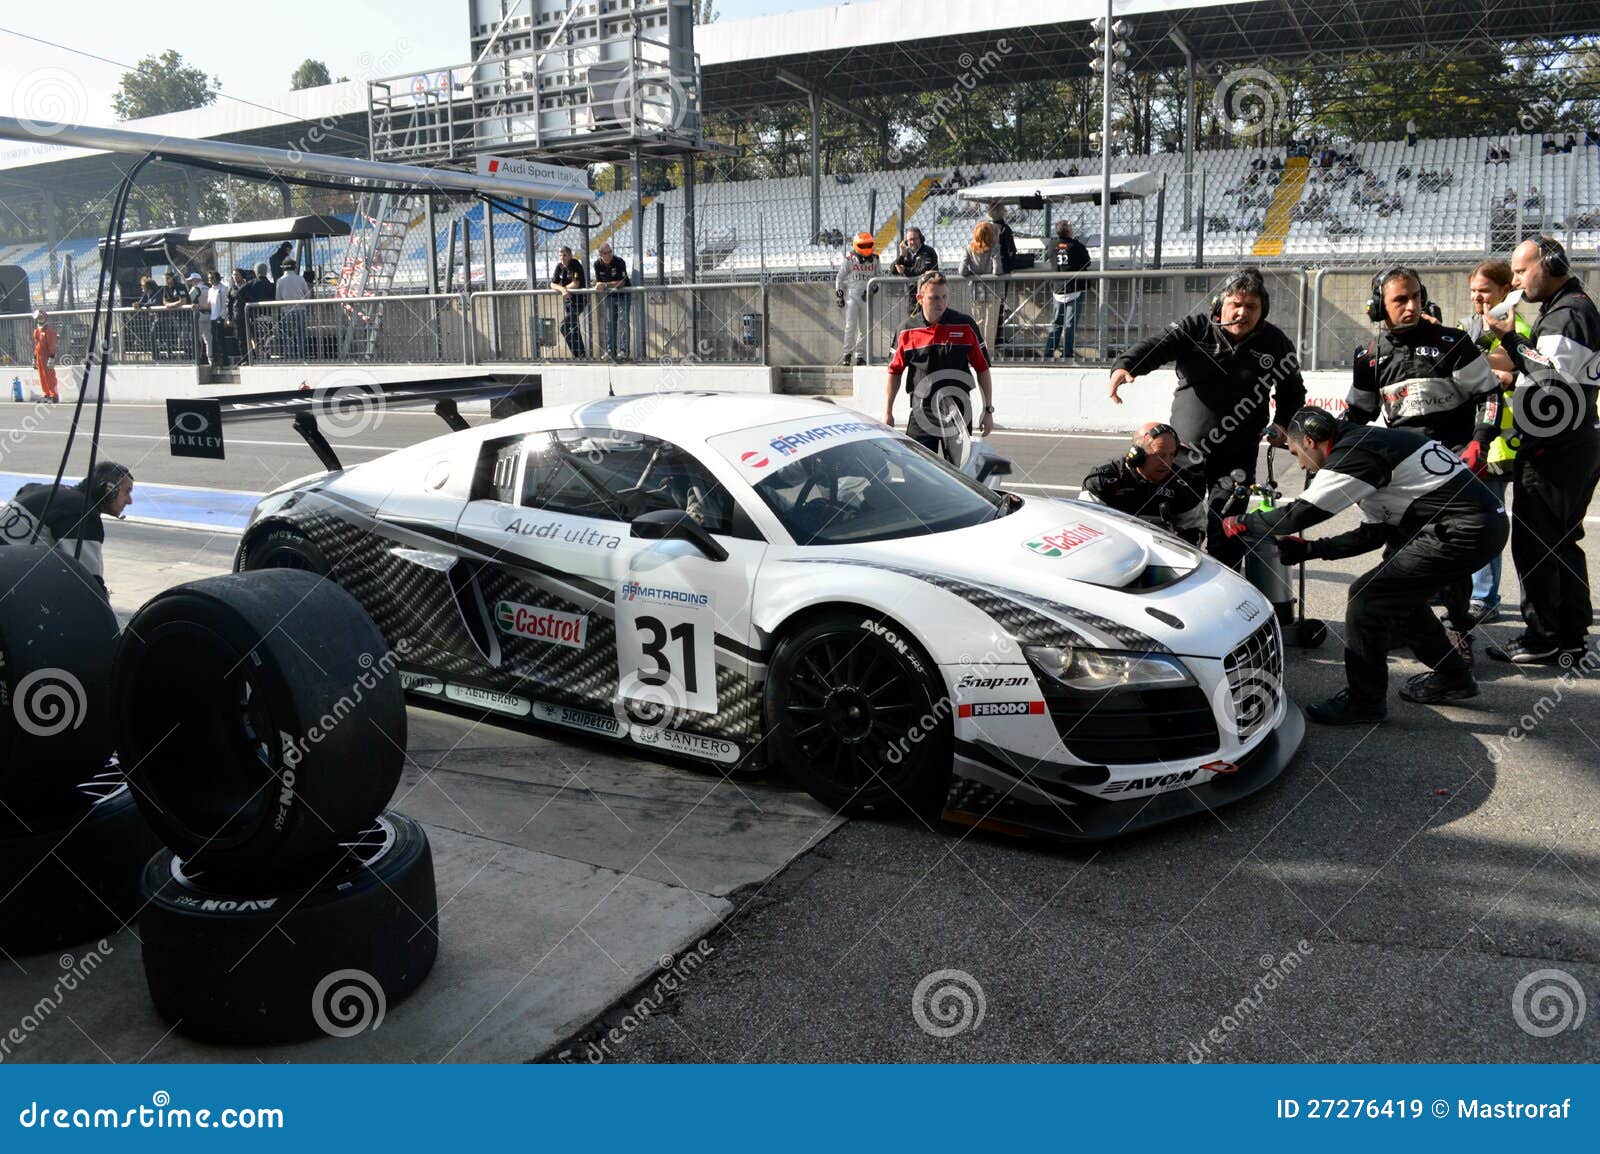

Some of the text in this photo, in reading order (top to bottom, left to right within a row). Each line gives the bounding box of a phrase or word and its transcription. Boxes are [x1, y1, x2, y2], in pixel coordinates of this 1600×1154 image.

[501, 162, 526, 175] Audi
[528, 165, 555, 179] Sport
[1056, 254, 1069, 265] 32
[170, 434, 221, 449] OAKLEY
[503, 518, 621, 549] Audi ultra
[1041, 522, 1105, 550] Castrol
[622, 583, 708, 606] ARMATRADING
[515, 607, 581, 643] Castrol
[860, 619, 908, 655] AVON
[634, 615, 698, 694] 31
[958, 675, 1029, 690] Snap-on
[974, 702, 1027, 715] FERODO
[663, 731, 730, 754] SANTERO
[280, 729, 296, 806] AVON
[1121, 768, 1200, 792] AVON
[200, 897, 278, 911] AVON
